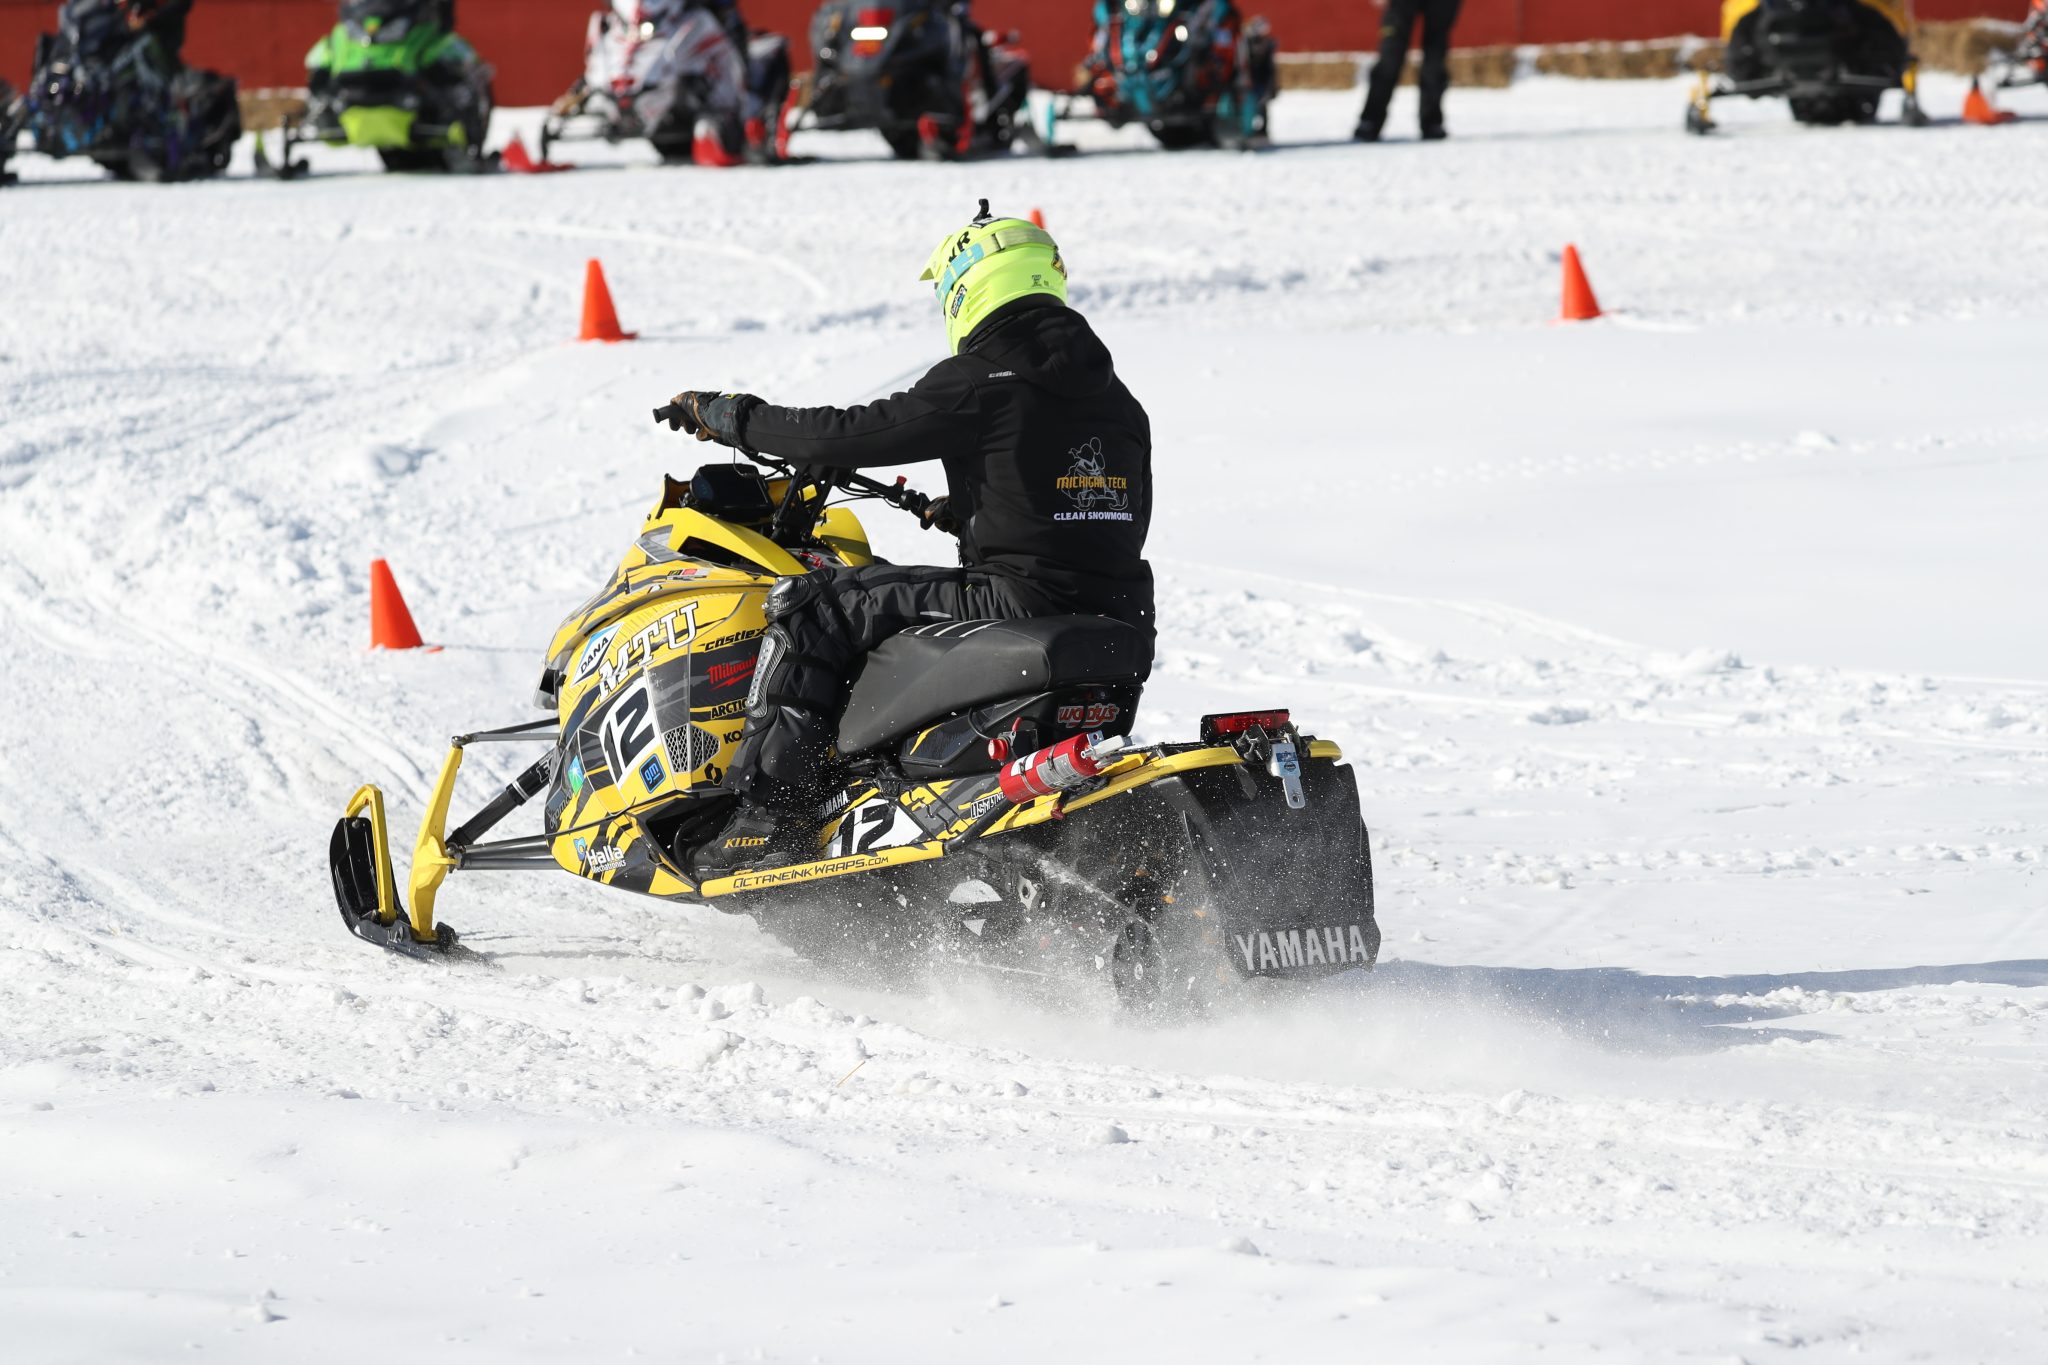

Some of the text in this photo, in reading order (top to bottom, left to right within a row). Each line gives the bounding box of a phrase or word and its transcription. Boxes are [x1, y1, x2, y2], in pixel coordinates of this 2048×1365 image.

[1056, 476, 1127, 489] MICHIGAN TECH
[1053, 511, 1086, 521] CLEAN
[579, 637, 610, 674] DANA
[598, 601, 699, 703] MTU
[604, 687, 656, 784] 12
[644, 762, 661, 785] gm
[837, 802, 898, 857] 12
[586, 845, 625, 867] Halla
[1234, 925, 1369, 971] YAMAHA
